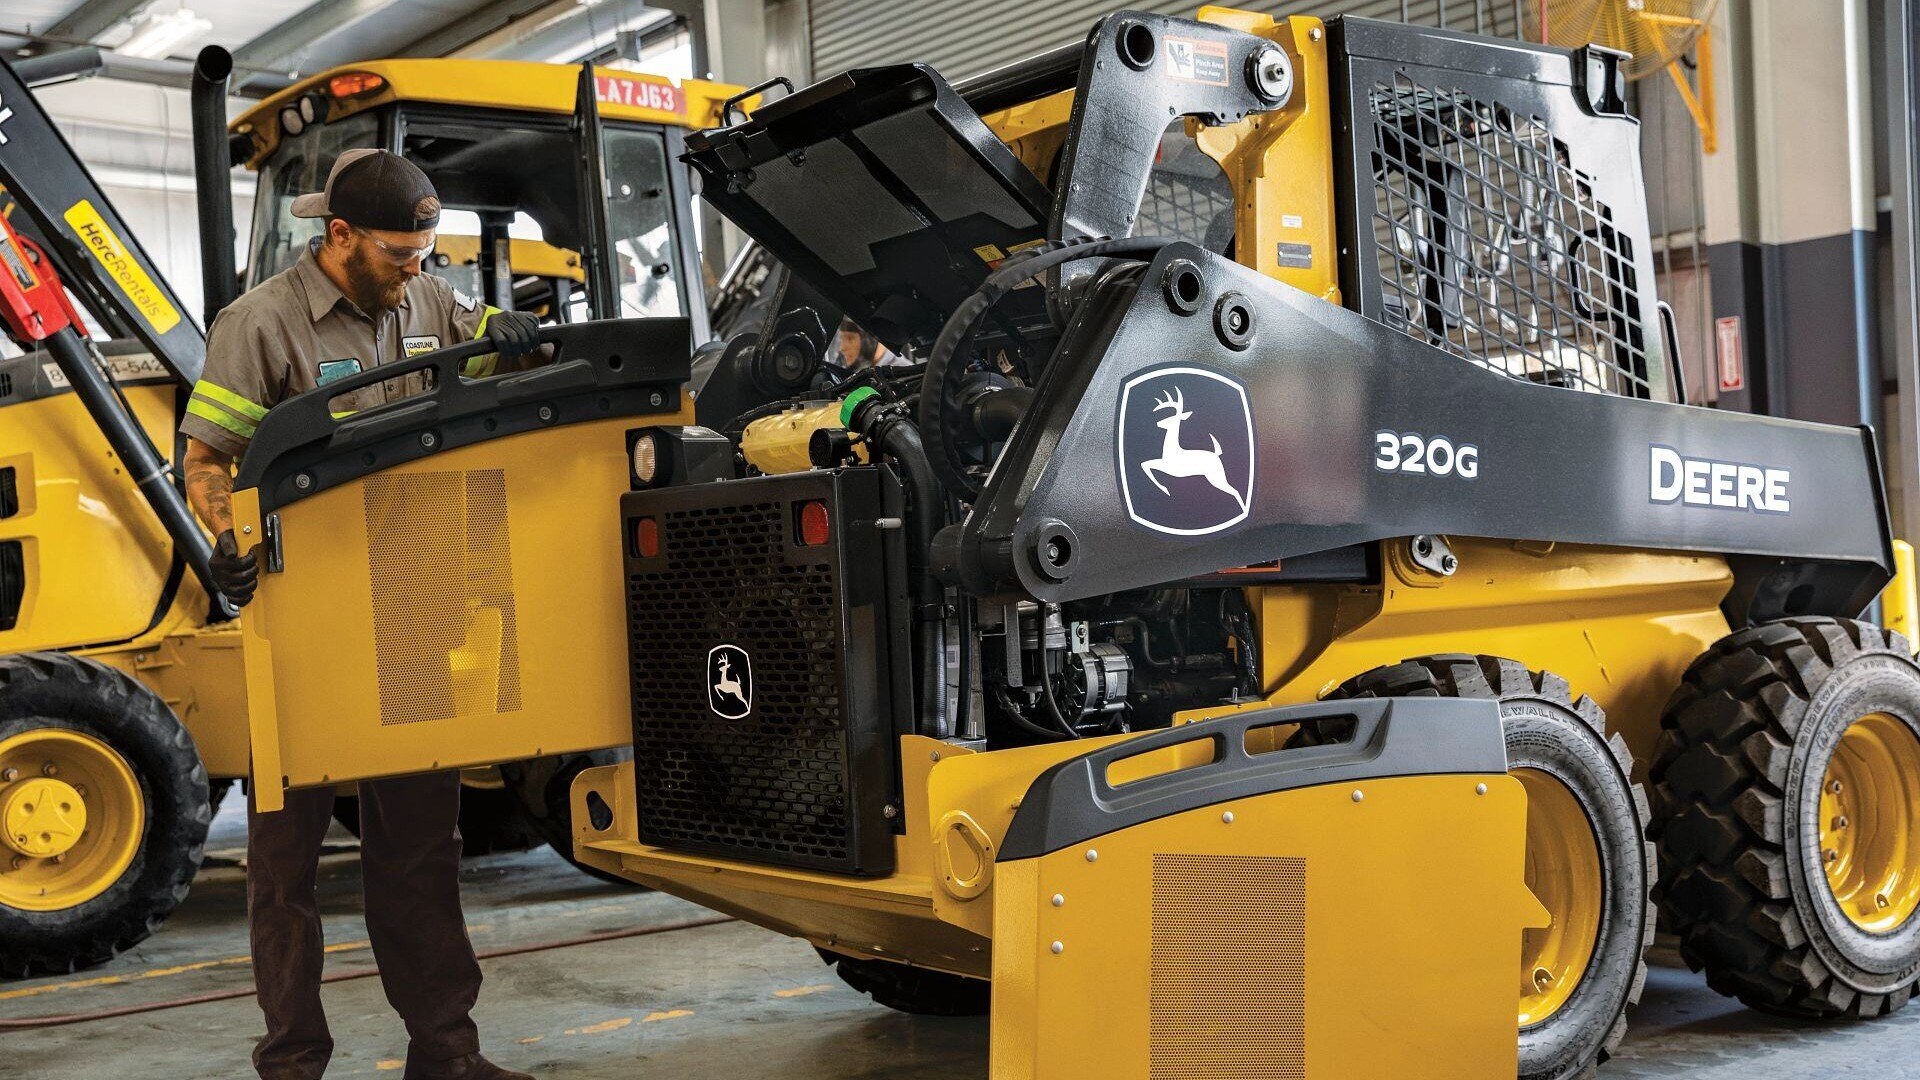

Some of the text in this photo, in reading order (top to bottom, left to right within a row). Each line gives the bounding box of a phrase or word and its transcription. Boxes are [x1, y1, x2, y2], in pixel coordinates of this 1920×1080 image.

[594, 77, 675, 111] LA7J63
[80, 222, 160, 318] HercRentals
[405, 340, 433, 350] COASTLINE
[1376, 432, 1478, 478] 320G
[1651, 447, 1790, 512] DEERE
[1501, 705, 1560, 722] EWALL
